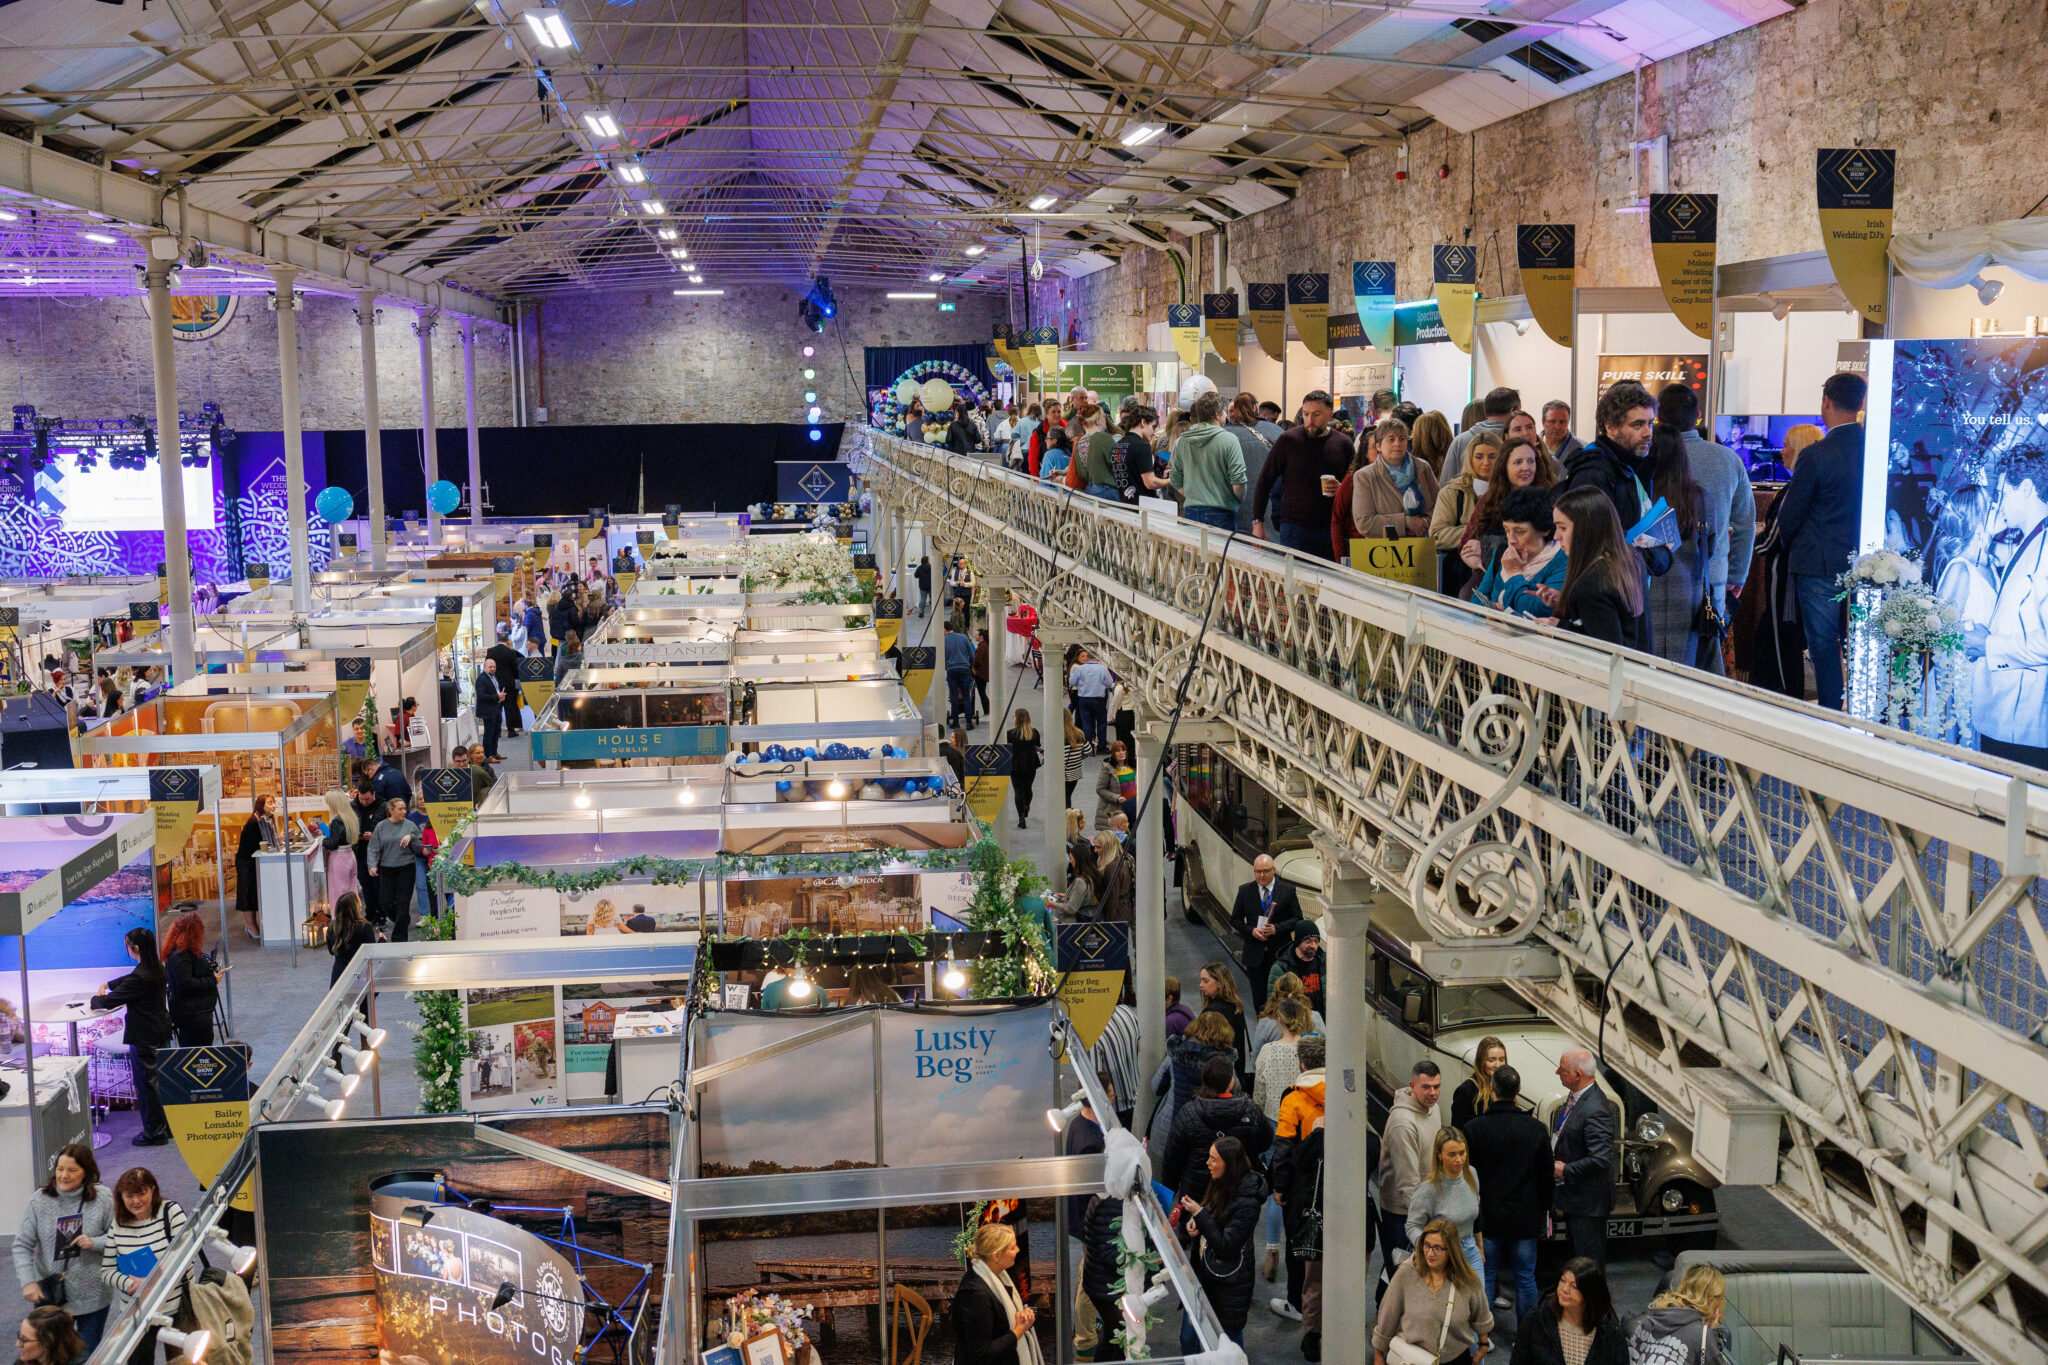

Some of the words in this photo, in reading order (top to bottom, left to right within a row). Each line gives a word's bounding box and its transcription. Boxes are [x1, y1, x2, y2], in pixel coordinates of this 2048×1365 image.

[1867, 220, 1885, 228] Irish
[1833, 231, 1867, 240] Wedding
[1688, 259, 1713, 267] Malone
[1683, 269, 1713, 277] Wedding
[1683, 288, 1698, 296] year
[1868, 305, 1882, 313] M2
[1329, 324, 1360, 339] TAPHOUSE
[1416, 323, 1448, 341] Productions
[1836, 361, 1851, 371] PURE
[1852, 361, 1867, 371] SKILL
[1601, 371, 1642, 380] PURE
[1645, 371, 1686, 380] SKILL
[1962, 413, 1986, 425] You
[1989, 413, 2011, 425] tell
[2015, 416, 2033, 425] us.
[1369, 545, 1416, 569] CM
[598, 734, 662, 745] HOUSE
[1086, 978, 1100, 986] Beg
[914, 1025, 997, 1056] Lusty
[914, 1055, 973, 1084] Beg
[215, 1110, 243, 1119] Bailey
[204, 1120, 244, 1130] Lonsdale
[186, 1131, 244, 1142] Photography
[235, 1192, 248, 1200] C3
[1608, 1222, 1636, 1236] 244
[429, 1295, 574, 1365] PHOTOG
